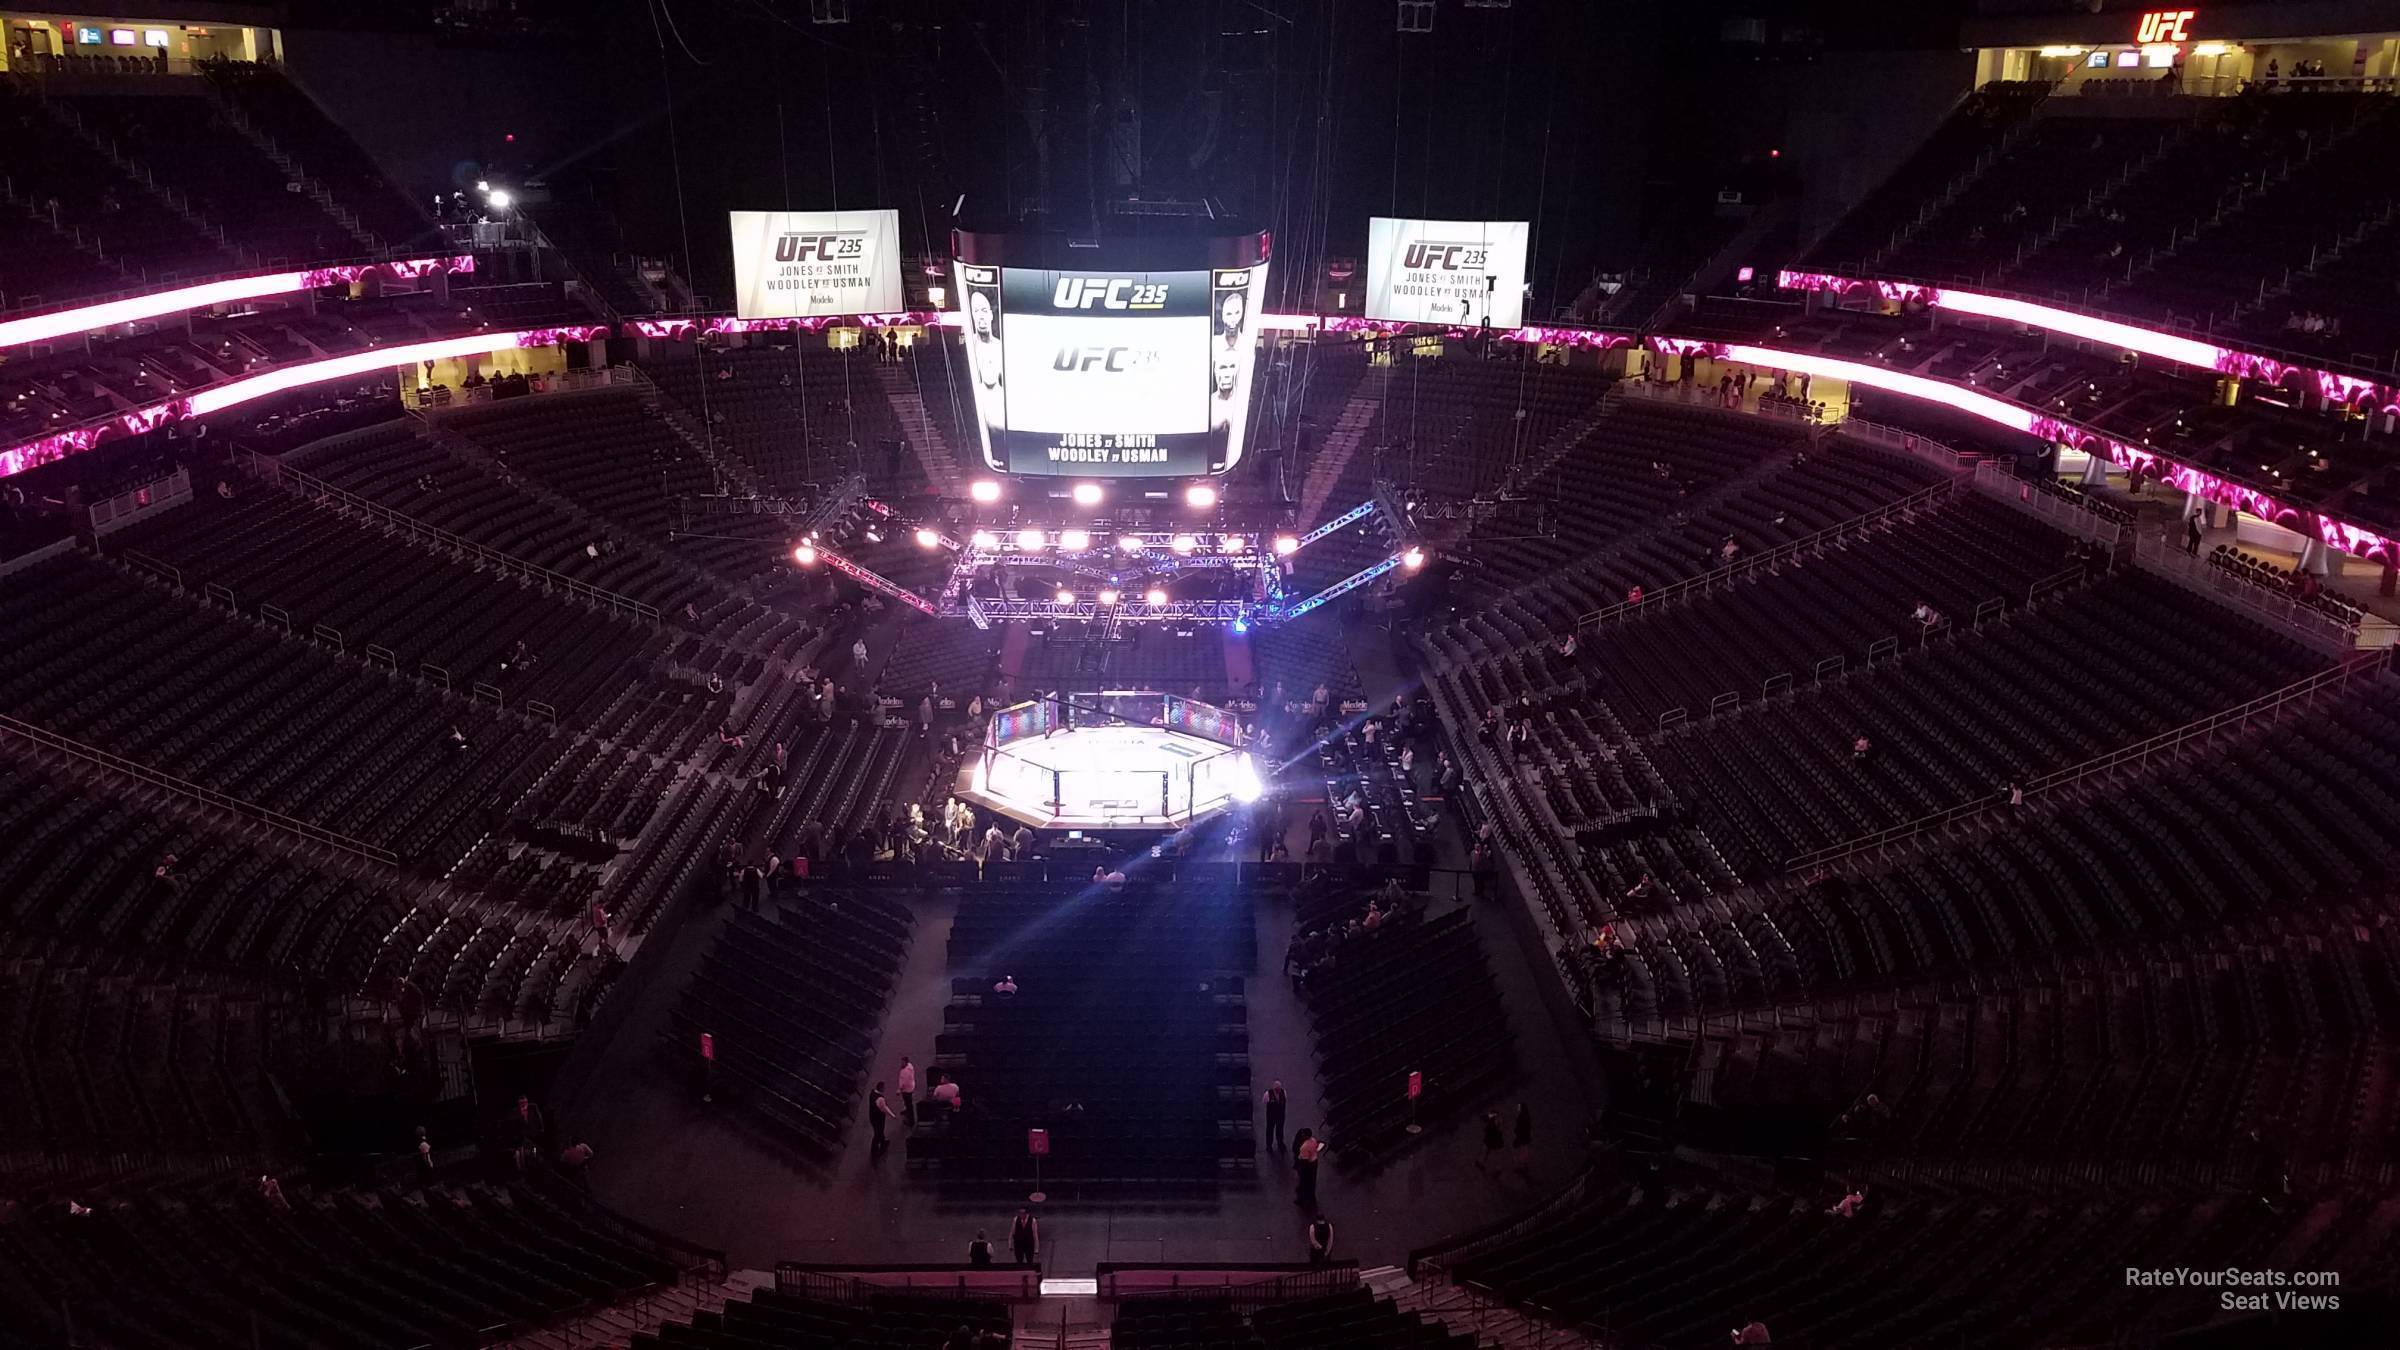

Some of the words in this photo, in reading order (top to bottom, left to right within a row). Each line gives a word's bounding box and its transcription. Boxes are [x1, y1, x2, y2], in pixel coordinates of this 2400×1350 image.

[2136, 10, 2195, 42] UFC
[775, 236, 837, 262] UFC
[837, 239, 863, 254] 235
[1403, 244, 1464, 270] UFC
[1463, 250, 1488, 264] 235
[779, 265, 813, 277] JONES
[827, 264, 859, 275] SMITH
[767, 279, 819, 290] WOODLEY
[833, 277, 871, 288] USMAN
[1406, 272, 1437, 284] JONES
[1450, 274, 1481, 285] SMITH
[1053, 277, 1133, 310] UFC
[1130, 284, 1169, 304] 235
[1394, 284, 1442, 297] WOODLEY
[1454, 287, 1491, 299] USMAN
[810, 295, 834, 304] Modelo
[1053, 346, 1129, 372] UFC
[1060, 433, 1102, 448] JONES
[1114, 434, 1156, 448] SMITH
[1048, 447, 1109, 462] WOODLEY
[1121, 448, 1168, 463] USMAN
